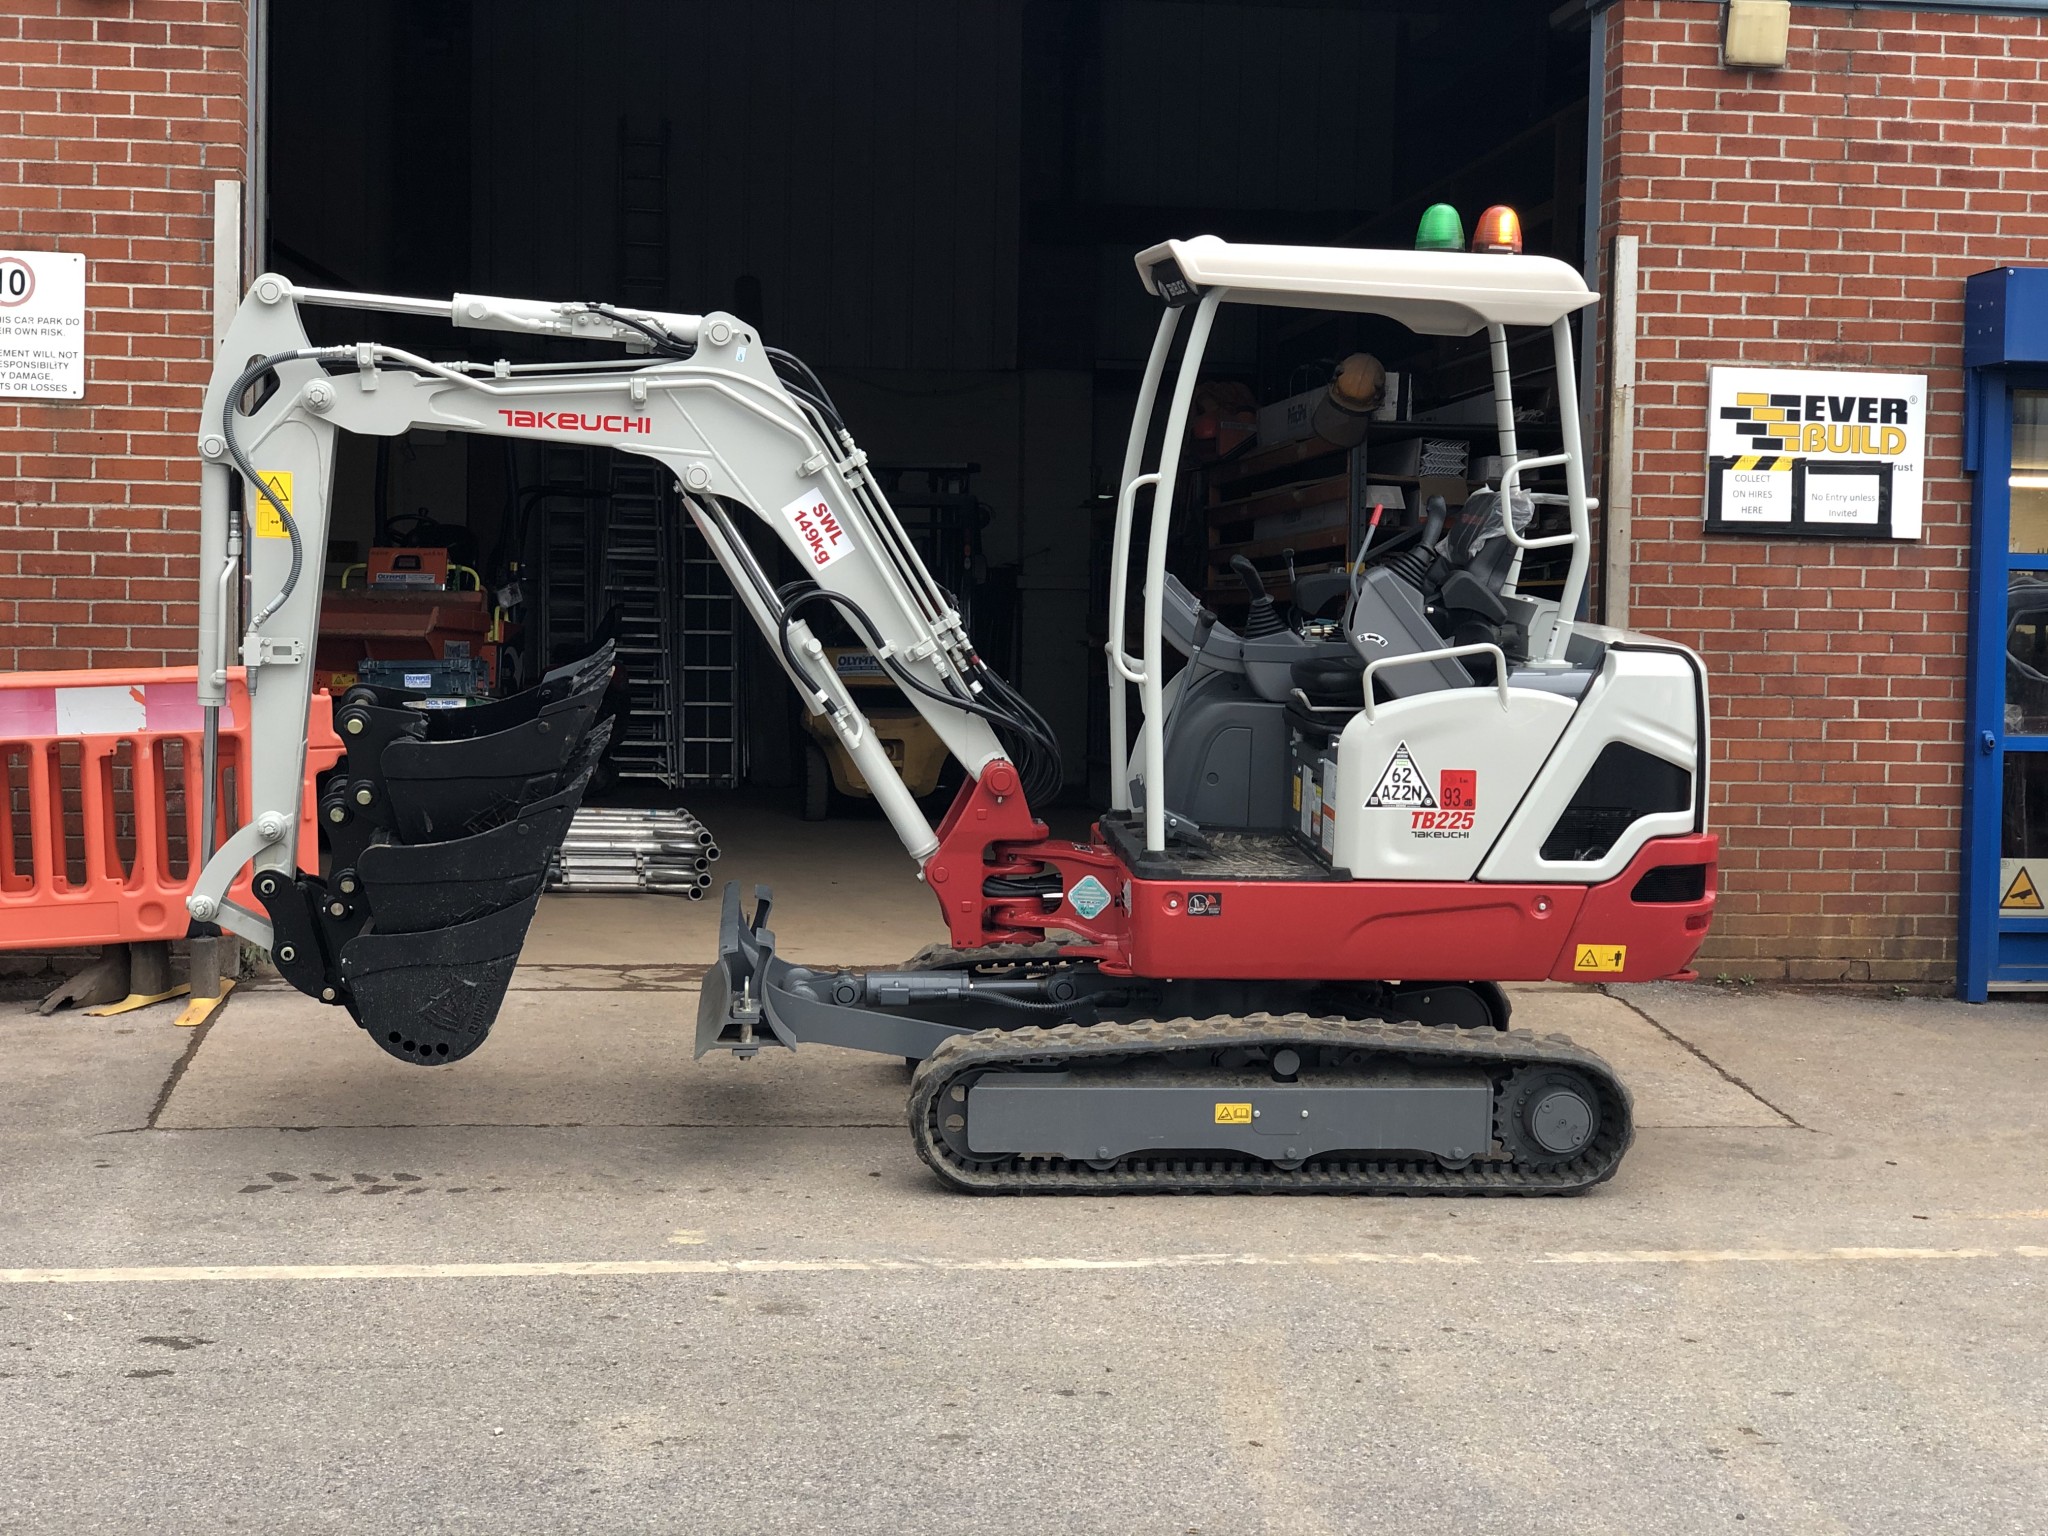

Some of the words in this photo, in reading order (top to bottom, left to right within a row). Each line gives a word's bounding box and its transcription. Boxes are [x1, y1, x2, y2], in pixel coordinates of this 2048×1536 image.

[14, 316, 34, 325] CAR
[37, 317, 63, 326] PARK
[65, 317, 80, 326] DO
[14, 327, 37, 336] OWN
[40, 328, 66, 337] RISK.
[33, 350, 56, 359] WILL
[58, 351, 79, 359] NOT
[13, 382, 28, 391] OR
[31, 383, 68, 392] LOSSES
[1804, 395, 1908, 425] EVER
[498, 410, 650, 434] TAKEUCHI
[1802, 423, 1907, 455] BUILD
[1734, 474, 1771, 482] COLLECT
[1732, 490, 1746, 498] ON
[1748, 491, 1773, 499] HIRES
[1811, 493, 1823, 501] No
[1825, 493, 1848, 503] Entry
[1850, 493, 1876, 502] unless
[1741, 506, 1763, 514] HERE
[1828, 509, 1857, 518] Invited
[813, 503, 842, 546] SWL
[794, 510, 830, 565] 149kg
[1392, 767, 1412, 783] 62
[1382, 785, 1422, 801] AZ2N
[1444, 787, 1461, 807] 93
[1411, 811, 1476, 830] TB225
[1411, 831, 1470, 839] TAKEUCHI
